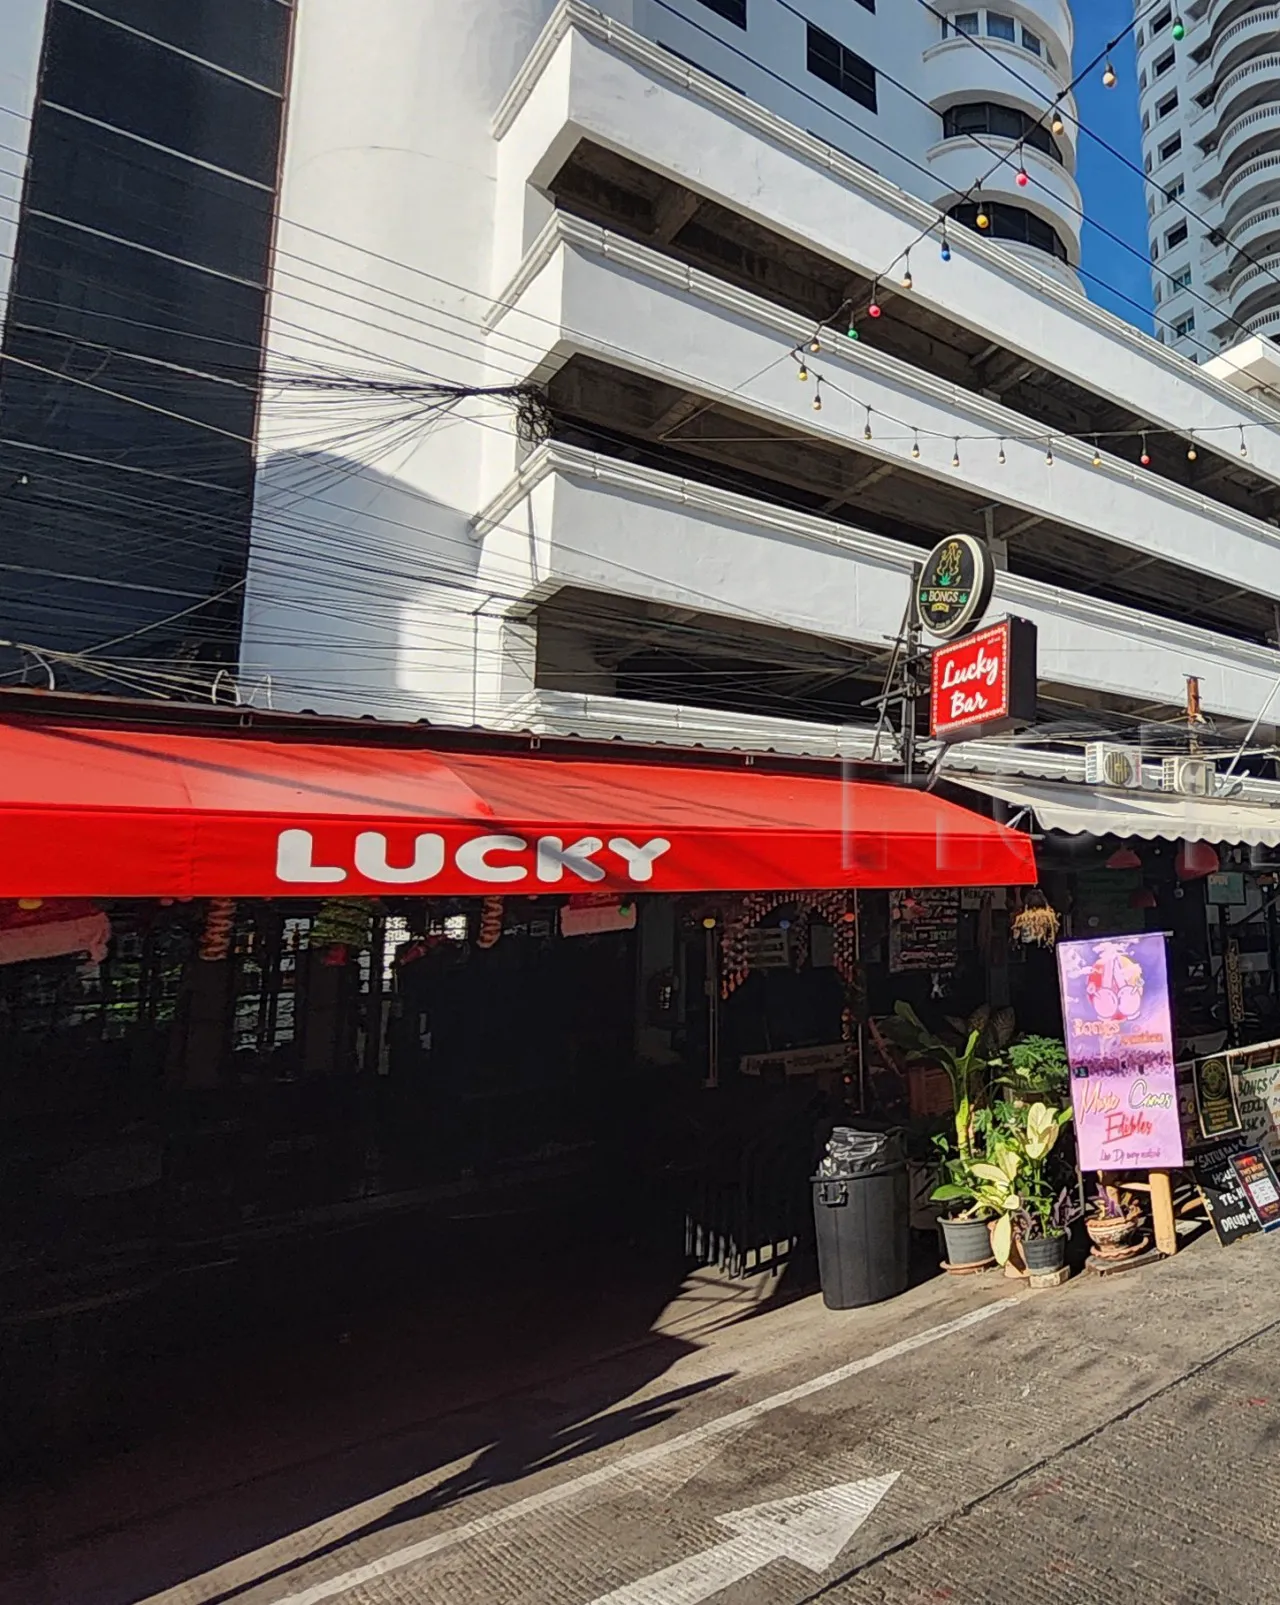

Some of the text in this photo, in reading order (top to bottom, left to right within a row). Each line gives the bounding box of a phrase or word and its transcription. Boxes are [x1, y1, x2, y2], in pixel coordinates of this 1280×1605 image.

[929, 590, 959, 602] BONGS
[941, 647, 999, 690] Lucky
[950, 690, 988, 718] Bar
[276, 828, 671, 883] LUCKY
